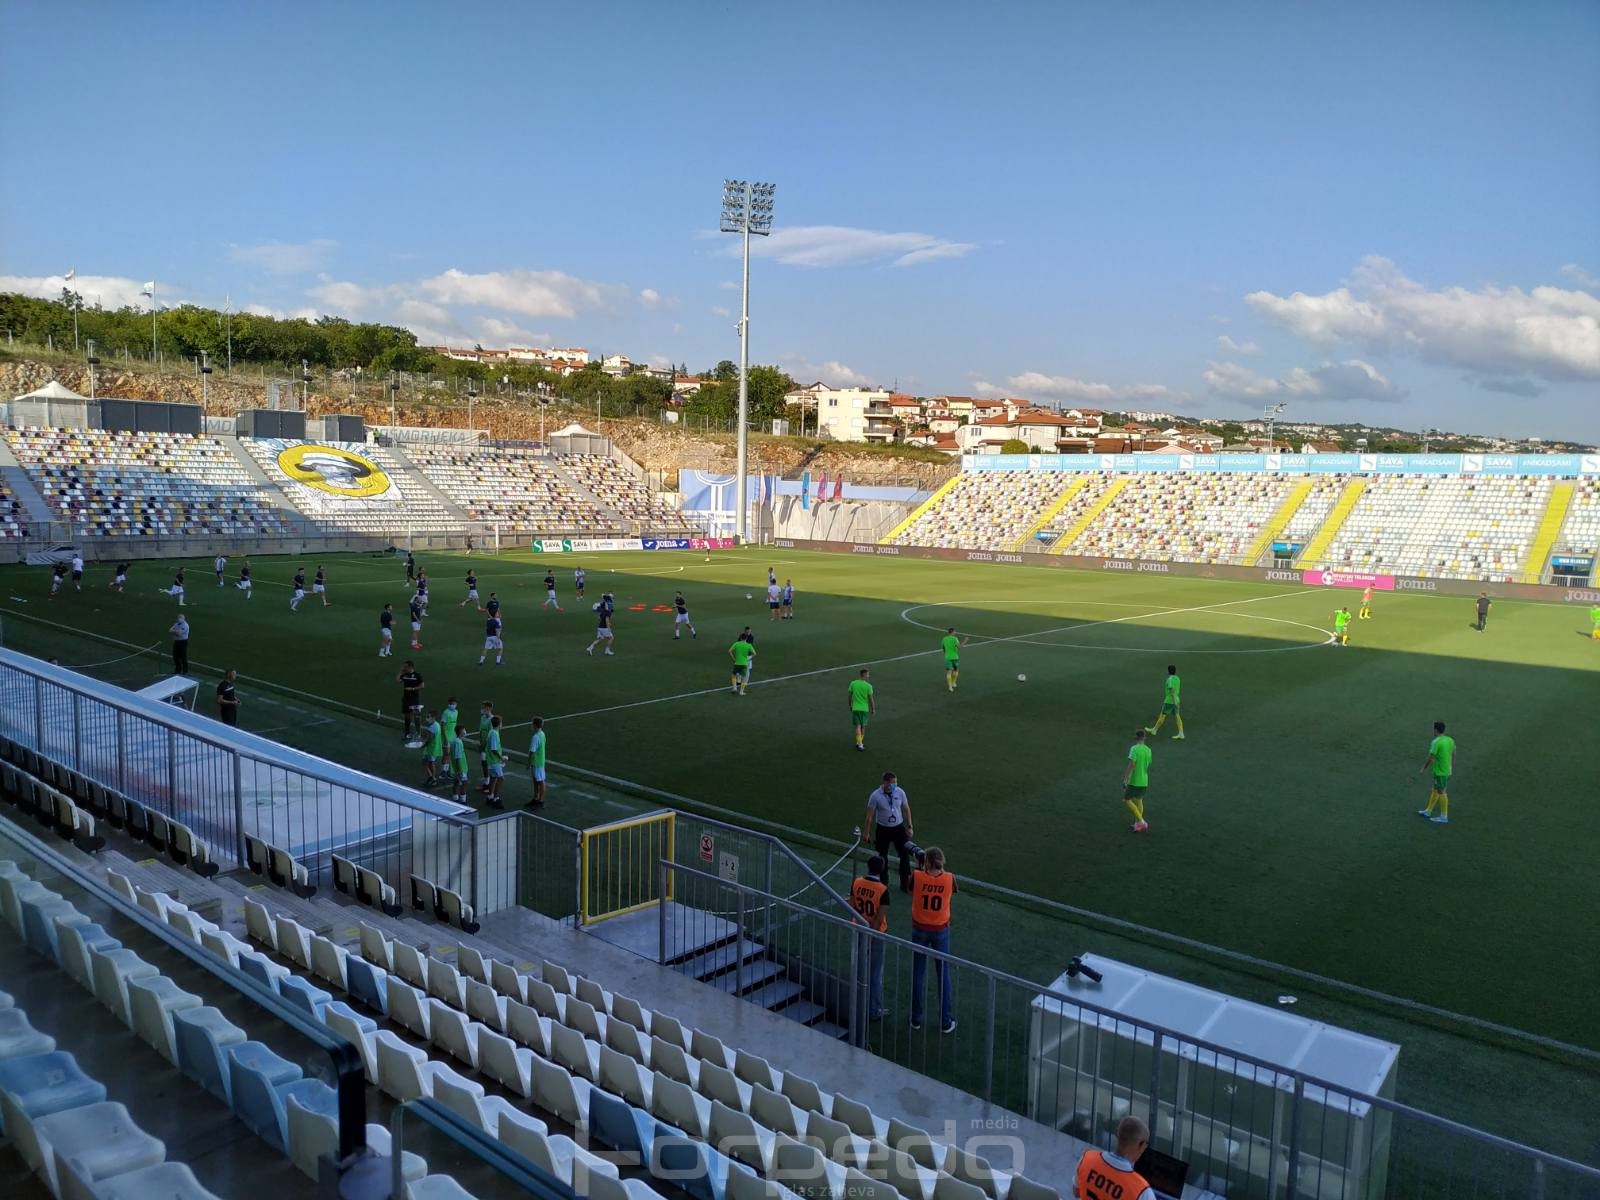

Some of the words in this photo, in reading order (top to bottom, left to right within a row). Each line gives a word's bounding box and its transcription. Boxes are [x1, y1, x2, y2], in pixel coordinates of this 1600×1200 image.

[1379, 457, 1404, 465] SAVA
[1486, 457, 1513, 466] SAVA
[857, 887, 875, 898] FOTO
[922, 883, 945, 893] FOTO
[855, 896, 875, 917] 30
[921, 894, 943, 912] 10
[1086, 1169, 1124, 1200] FOTO
